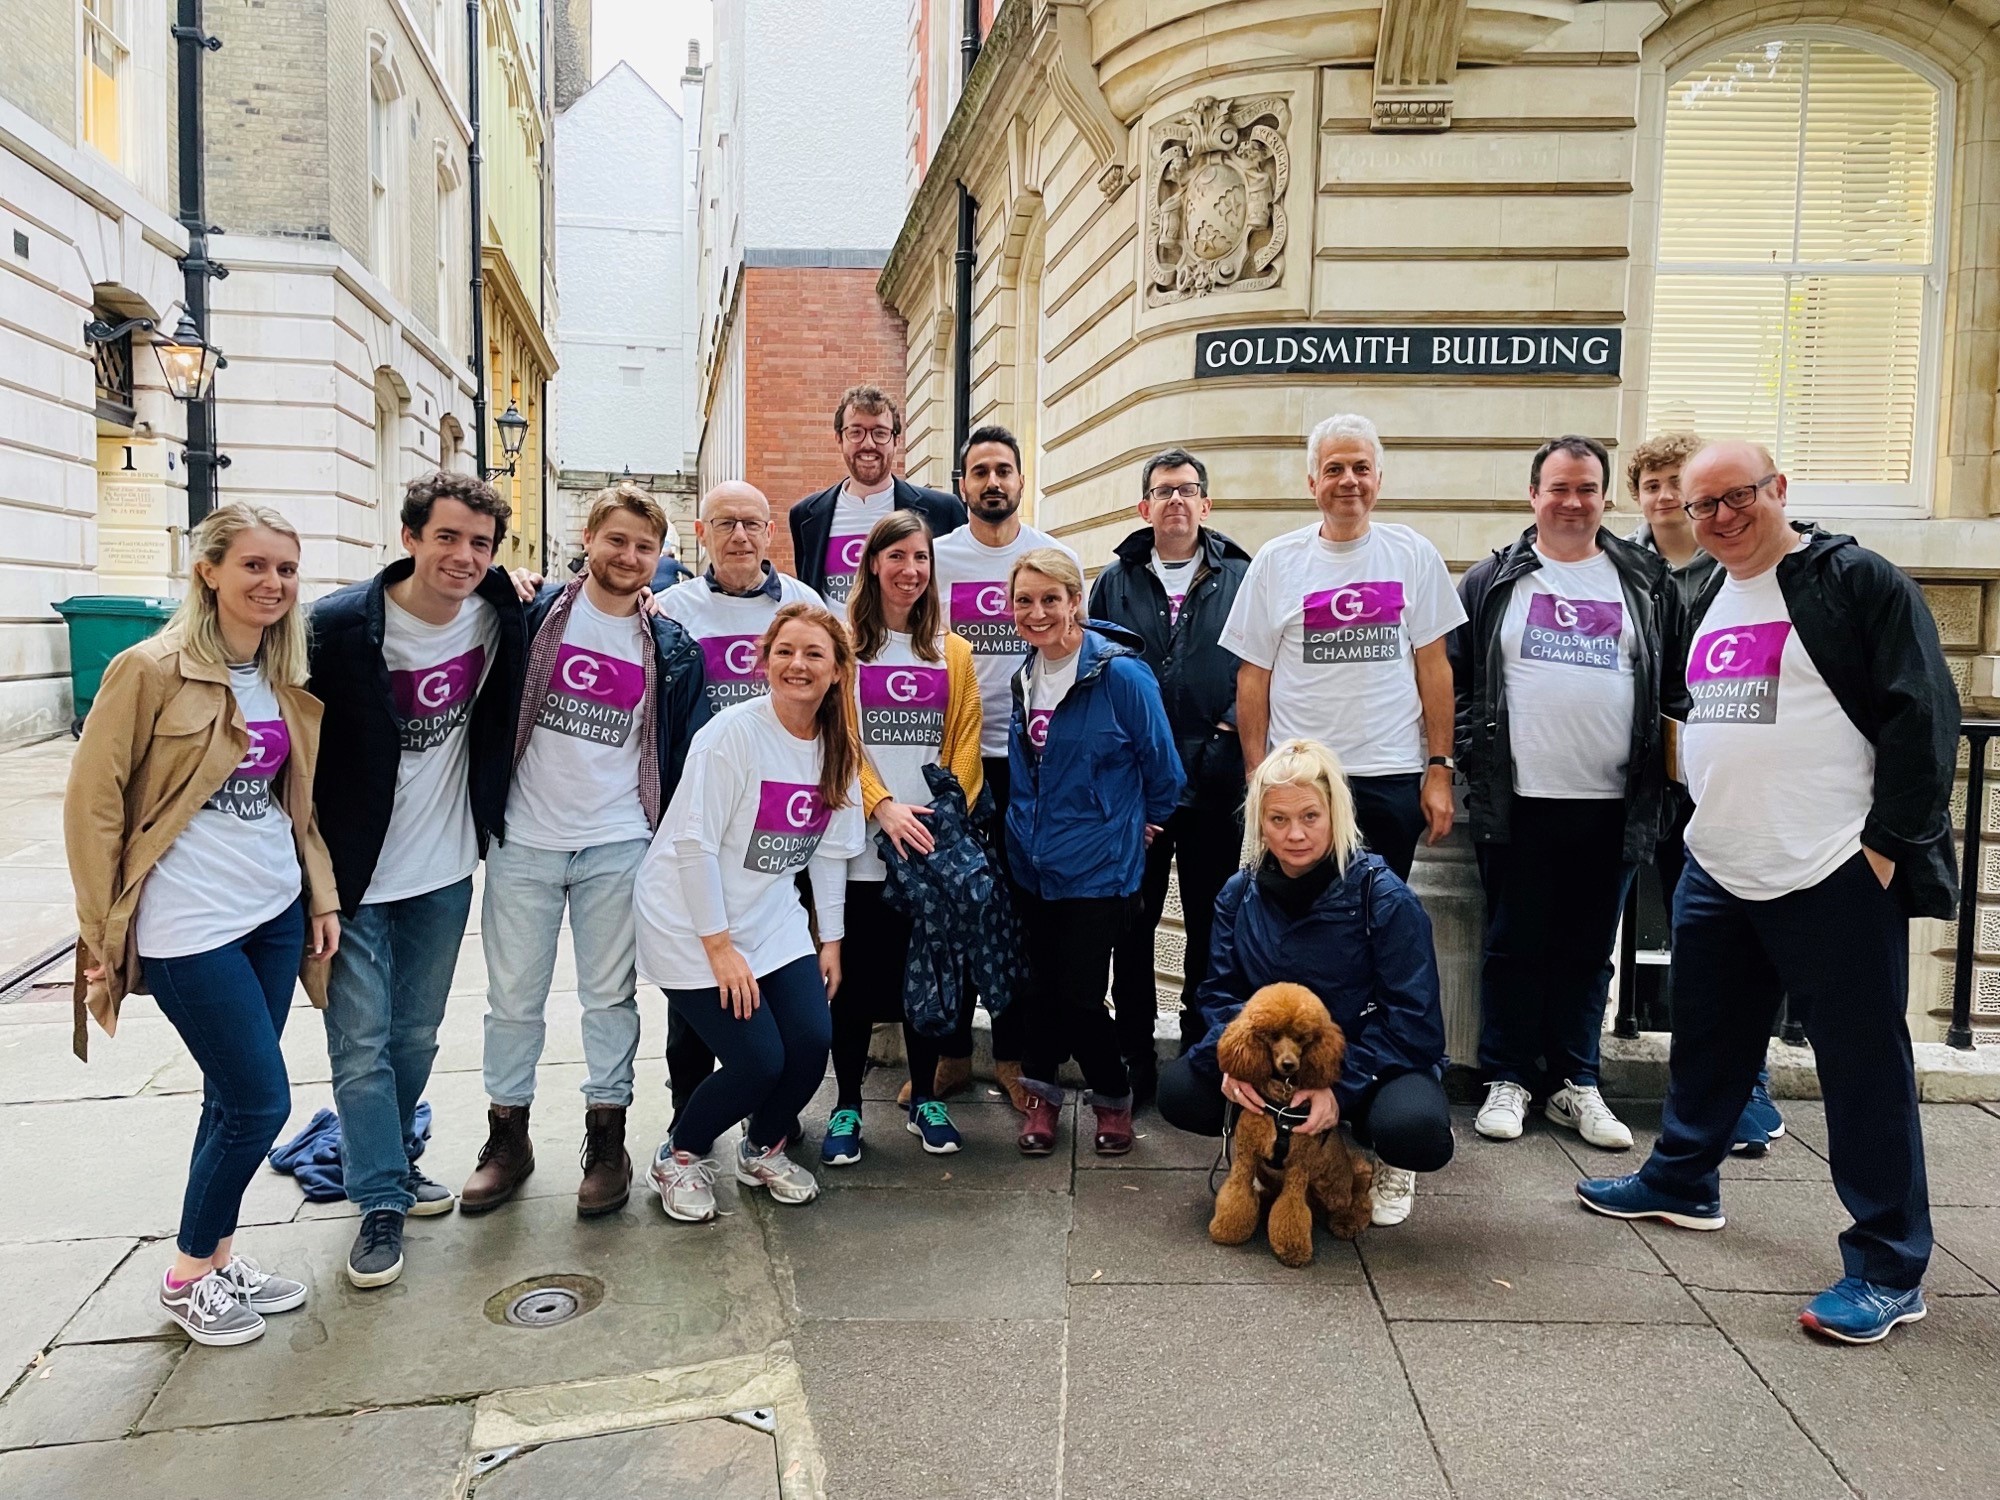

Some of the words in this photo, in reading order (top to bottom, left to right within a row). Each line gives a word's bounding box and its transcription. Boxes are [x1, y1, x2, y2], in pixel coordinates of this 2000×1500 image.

[1205, 337, 1410, 368] GOLDSMITH
[1432, 336, 1610, 365] BUILDING
[121, 446, 137, 470] 1
[841, 539, 867, 568] G
[1330, 587, 1382, 622] GC
[1555, 600, 1595, 631] GC
[957, 624, 1019, 636] GOLDSM
[1310, 626, 1398, 643] GOLDSMITH
[1530, 629, 1615, 651] GOLDSMITH
[725, 640, 763, 674] G
[971, 640, 1032, 652] HAMBER
[1312, 644, 1396, 660] CHAMBERS
[1530, 645, 1611, 666] CHAMBERS
[1705, 632, 1757, 674] GC
[562, 654, 619, 696] GC
[886, 670, 936, 702] GC
[705, 682, 772, 698] GOLDSM
[1689, 681, 1769, 699] OLDSMITH
[546, 693, 630, 727] OLDSMITH
[1687, 703, 1760, 720] AMBERS
[871, 728, 942, 744] CHAMBERS
[1027, 714, 1050, 747] G
